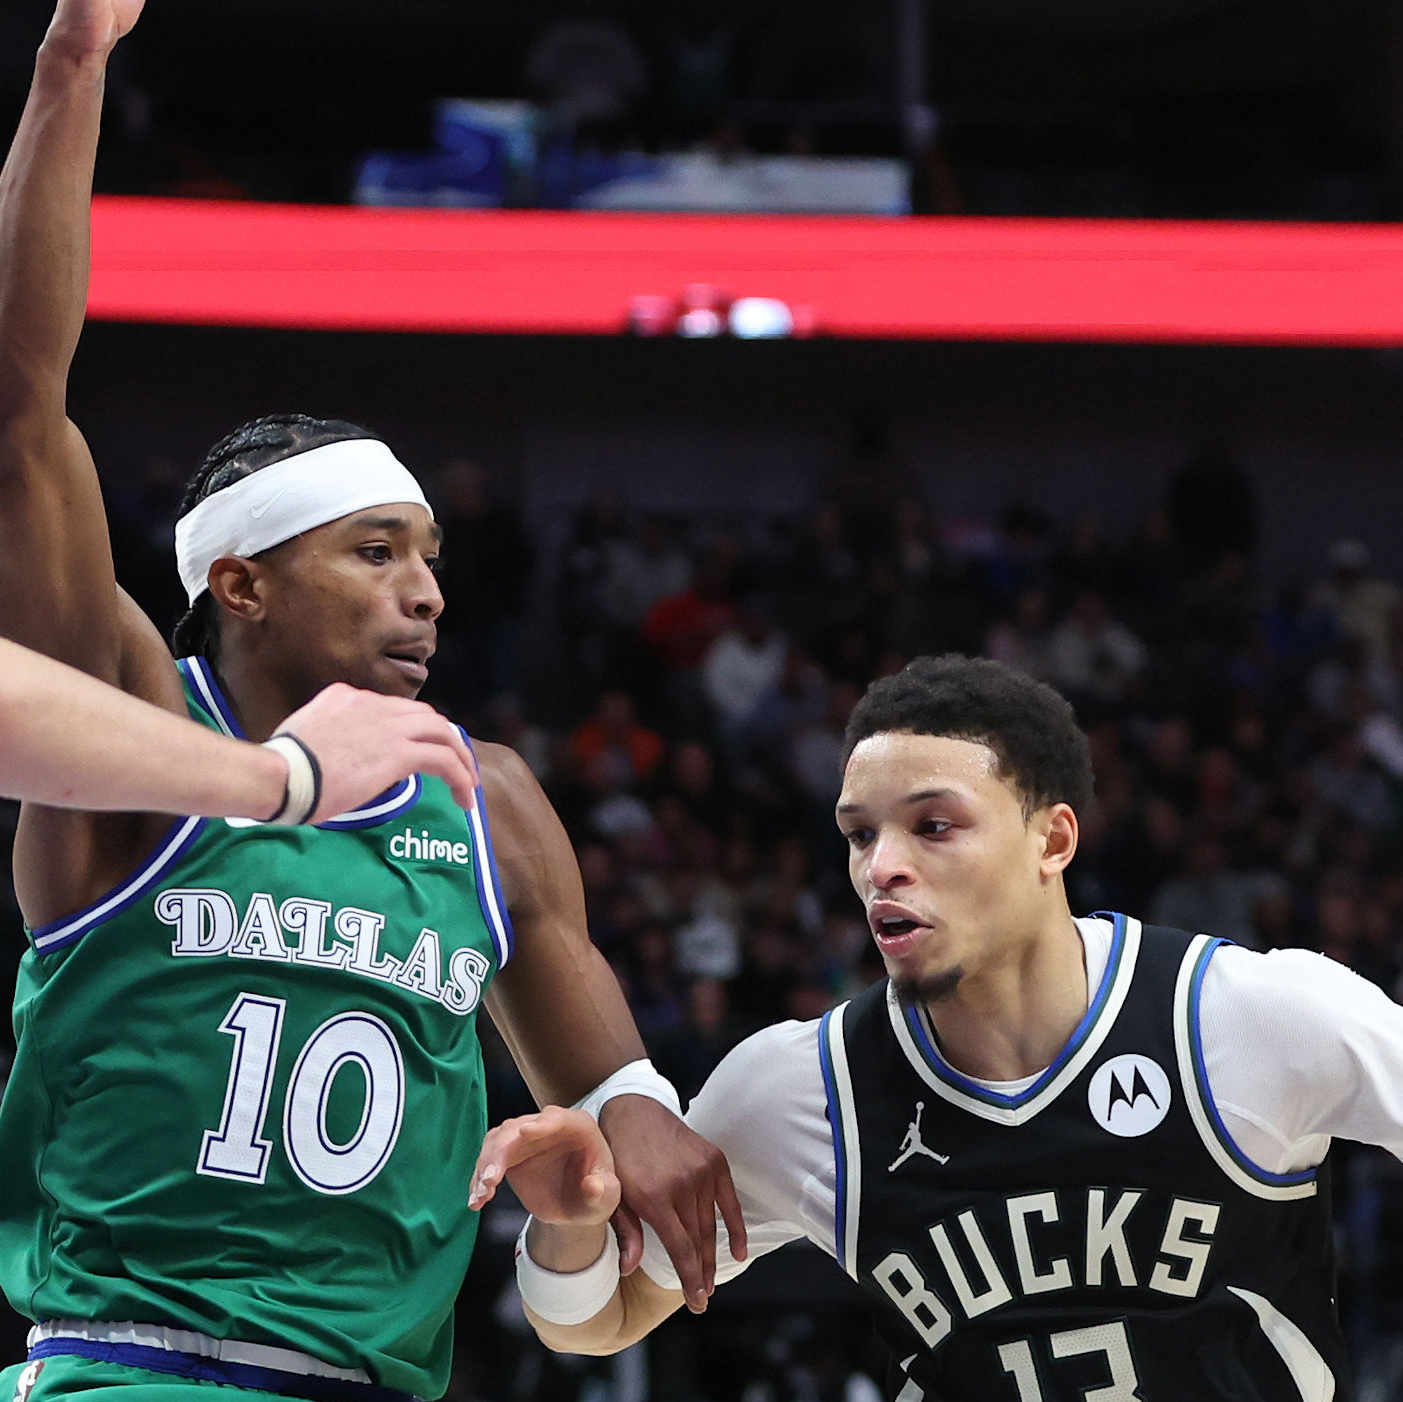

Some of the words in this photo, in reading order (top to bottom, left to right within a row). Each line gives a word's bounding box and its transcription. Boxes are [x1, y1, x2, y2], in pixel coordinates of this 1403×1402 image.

[389, 828, 469, 864] chime
[154, 888, 490, 1016] DALLAS
[196, 992, 405, 1195] 10
[871, 1187, 1222, 1350] BUCKS
